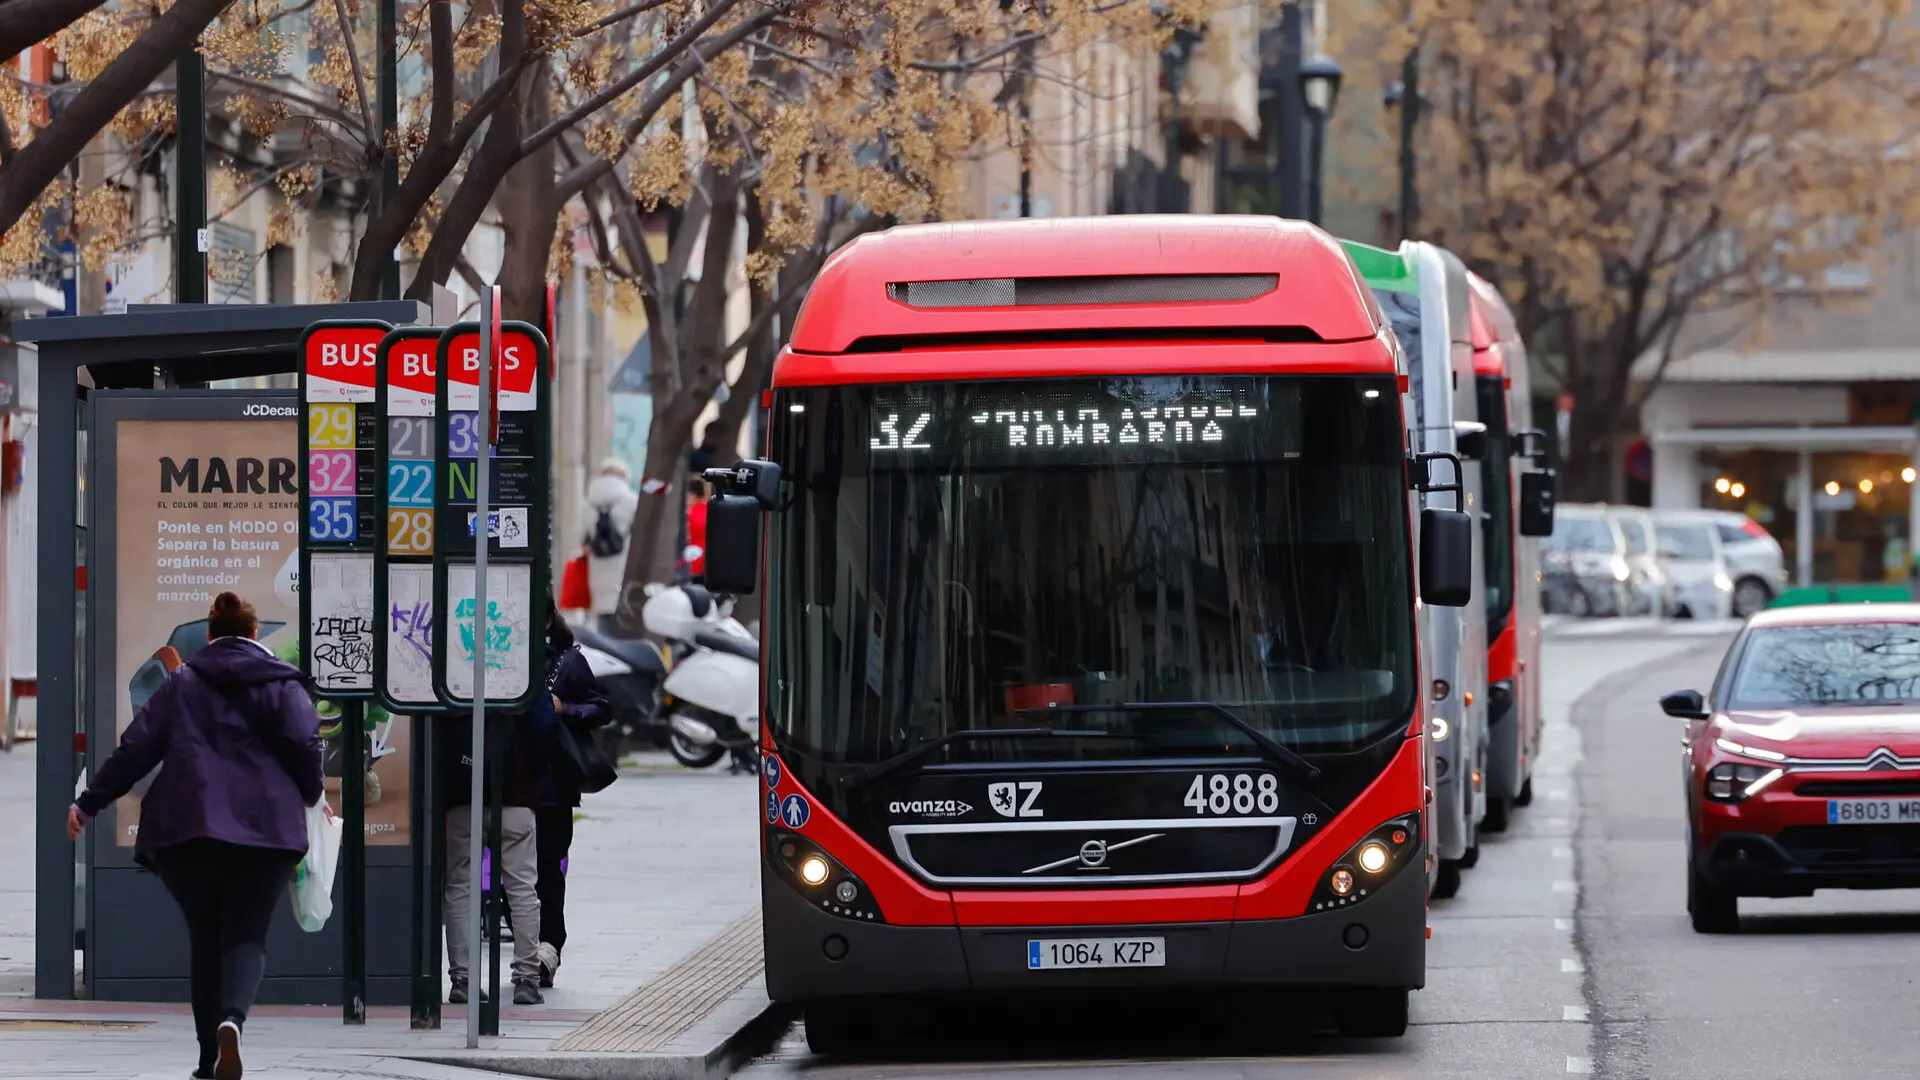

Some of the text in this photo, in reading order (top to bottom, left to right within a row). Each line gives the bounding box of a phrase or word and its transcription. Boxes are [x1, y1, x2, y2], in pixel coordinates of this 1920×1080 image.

[322, 343, 376, 366] BUS
[463, 347, 520, 371] BS
[242, 404, 299, 416] JCDecau
[309, 407, 353, 445] 29
[391, 417, 428, 456] 21
[158, 456, 299, 495] MARR
[309, 453, 352, 492] 32
[389, 464, 432, 503] 22
[157, 501, 299, 510] EL COLOR QUE MEJOR LE SIENTA
[157, 520, 201, 534] Ponte
[205, 523, 224, 534] en
[228, 520, 278, 534] MODO
[310, 500, 353, 539] 35
[389, 511, 432, 551] 28
[157, 538, 280, 552] Separa la basura
[157, 555, 261, 569] orgánica en el
[157, 572, 241, 585] contenedor
[1018, 781, 1044, 818] Z
[1184, 773, 1279, 814] 4888
[889, 800, 956, 813] avanza
[1841, 802, 1891, 820] 6803
[1051, 943, 1103, 964] 1064
[1114, 942, 1155, 963] KZP
